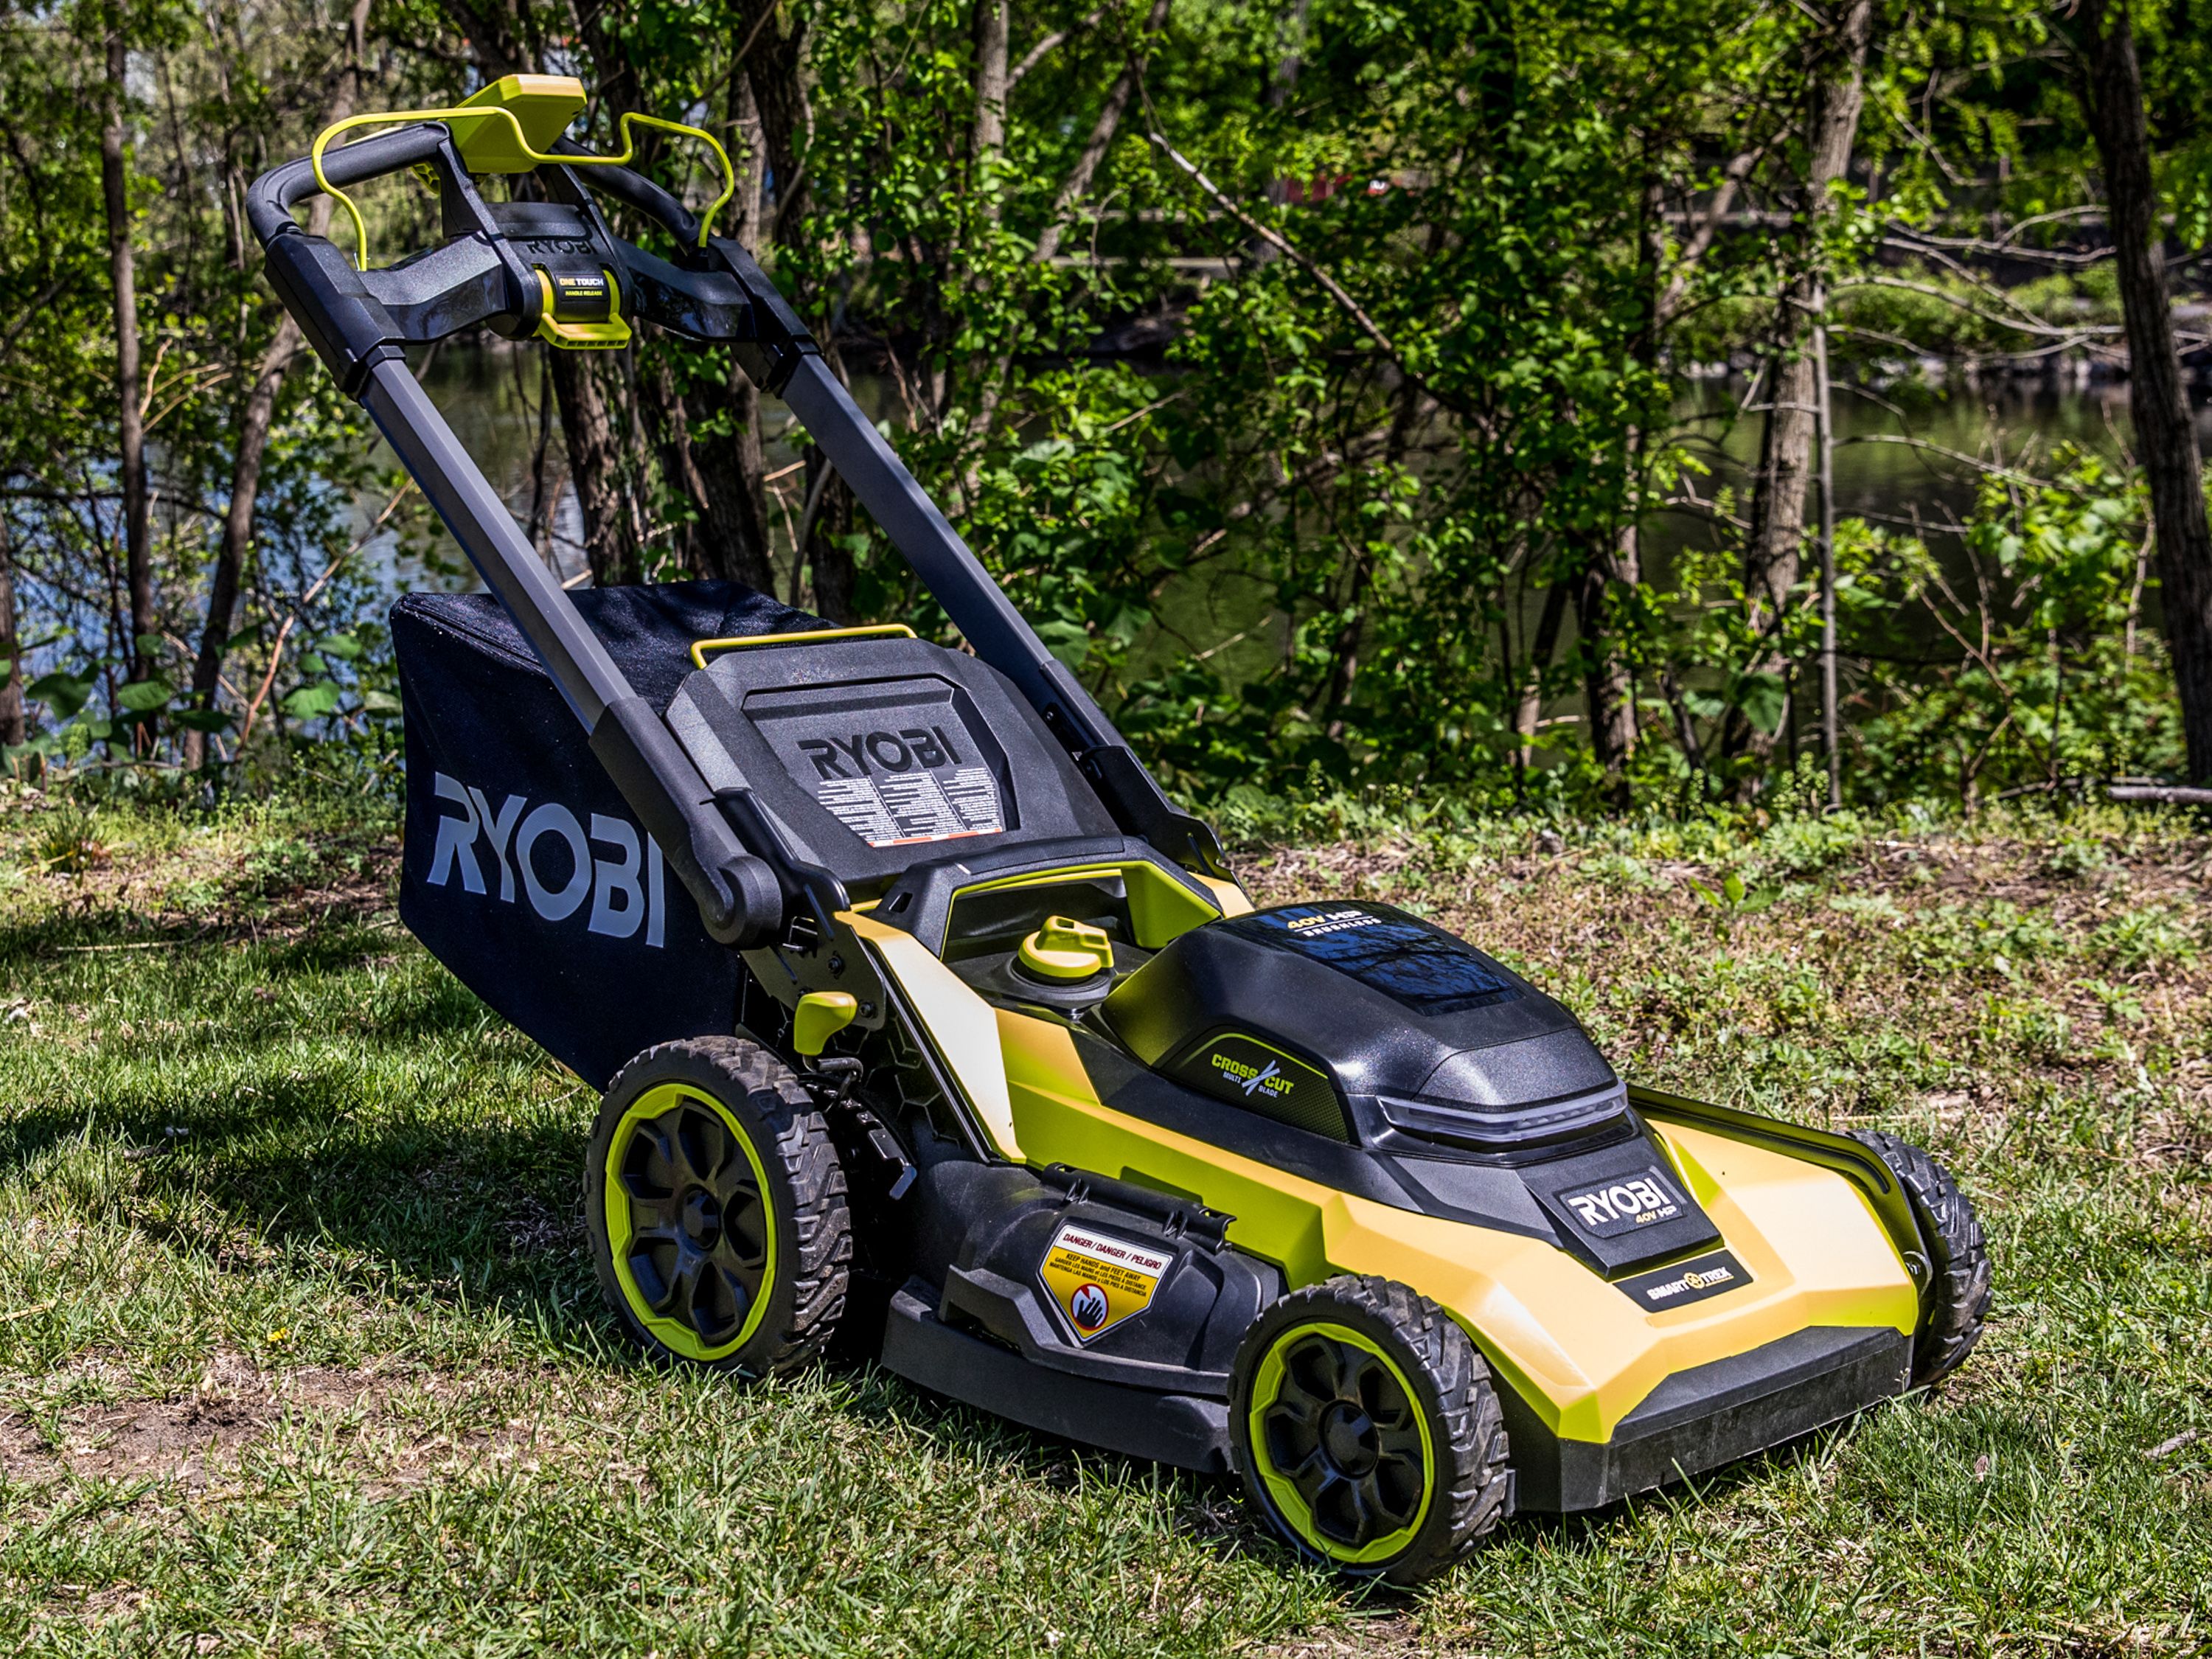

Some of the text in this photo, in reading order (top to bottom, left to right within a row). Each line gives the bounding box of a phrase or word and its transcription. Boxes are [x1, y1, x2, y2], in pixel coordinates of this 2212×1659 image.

[526, 240, 599, 254] RYOBI
[560, 277, 604, 286] ONE TOUCH
[796, 726, 962, 779] RYOBI
[427, 771, 664, 947] RYOBI
[1287, 911, 1363, 929] 40V HP
[1211, 1054, 1294, 1095] CROSS CUT
[1222, 1071, 1242, 1084] MULTI
[1258, 1085, 1279, 1098] BLADE
[1568, 1178, 1672, 1226] RYOBI
[1635, 1205, 1677, 1224] 40V HP
[1063, 1233, 1093, 1248] DANGER
[1096, 1243, 1127, 1259] DANGER
[1130, 1254, 1162, 1270] PELIGRO
[1065, 1253, 1080, 1262] KEEP
[1080, 1258, 1099, 1268] HANDS
[1110, 1267, 1124, 1276] FEET
[1124, 1272, 1141, 1281] AWAY
[1646, 1267, 1732, 1301] SMART TREK
